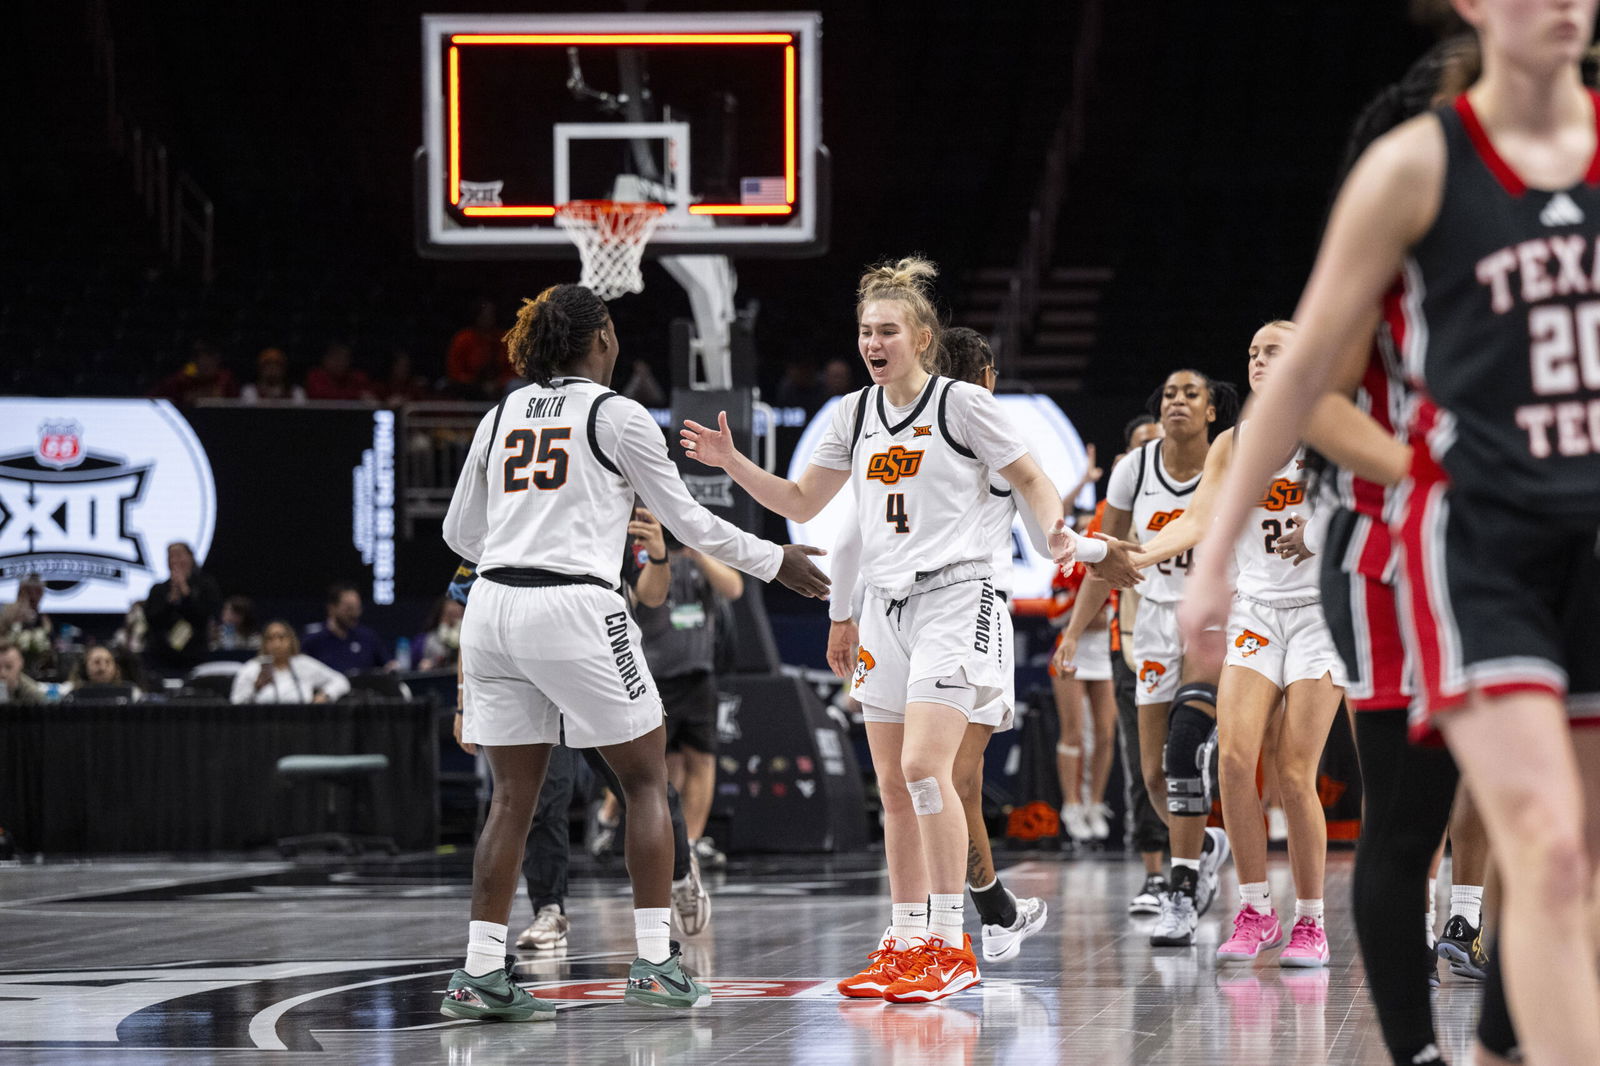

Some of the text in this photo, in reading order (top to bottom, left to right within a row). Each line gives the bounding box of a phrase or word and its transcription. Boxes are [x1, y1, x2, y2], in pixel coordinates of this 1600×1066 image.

[1475, 234, 1600, 314] TEX
[526, 396, 566, 419] SMITH
[504, 426, 572, 493] 25
[866, 445, 925, 485] OSU
[886, 493, 910, 534] 4
[1255, 478, 1308, 511] SU
[1261, 519, 1300, 554] 2
[973, 577, 995, 655] COWGIRL
[605, 611, 646, 700] COWGIRLS
